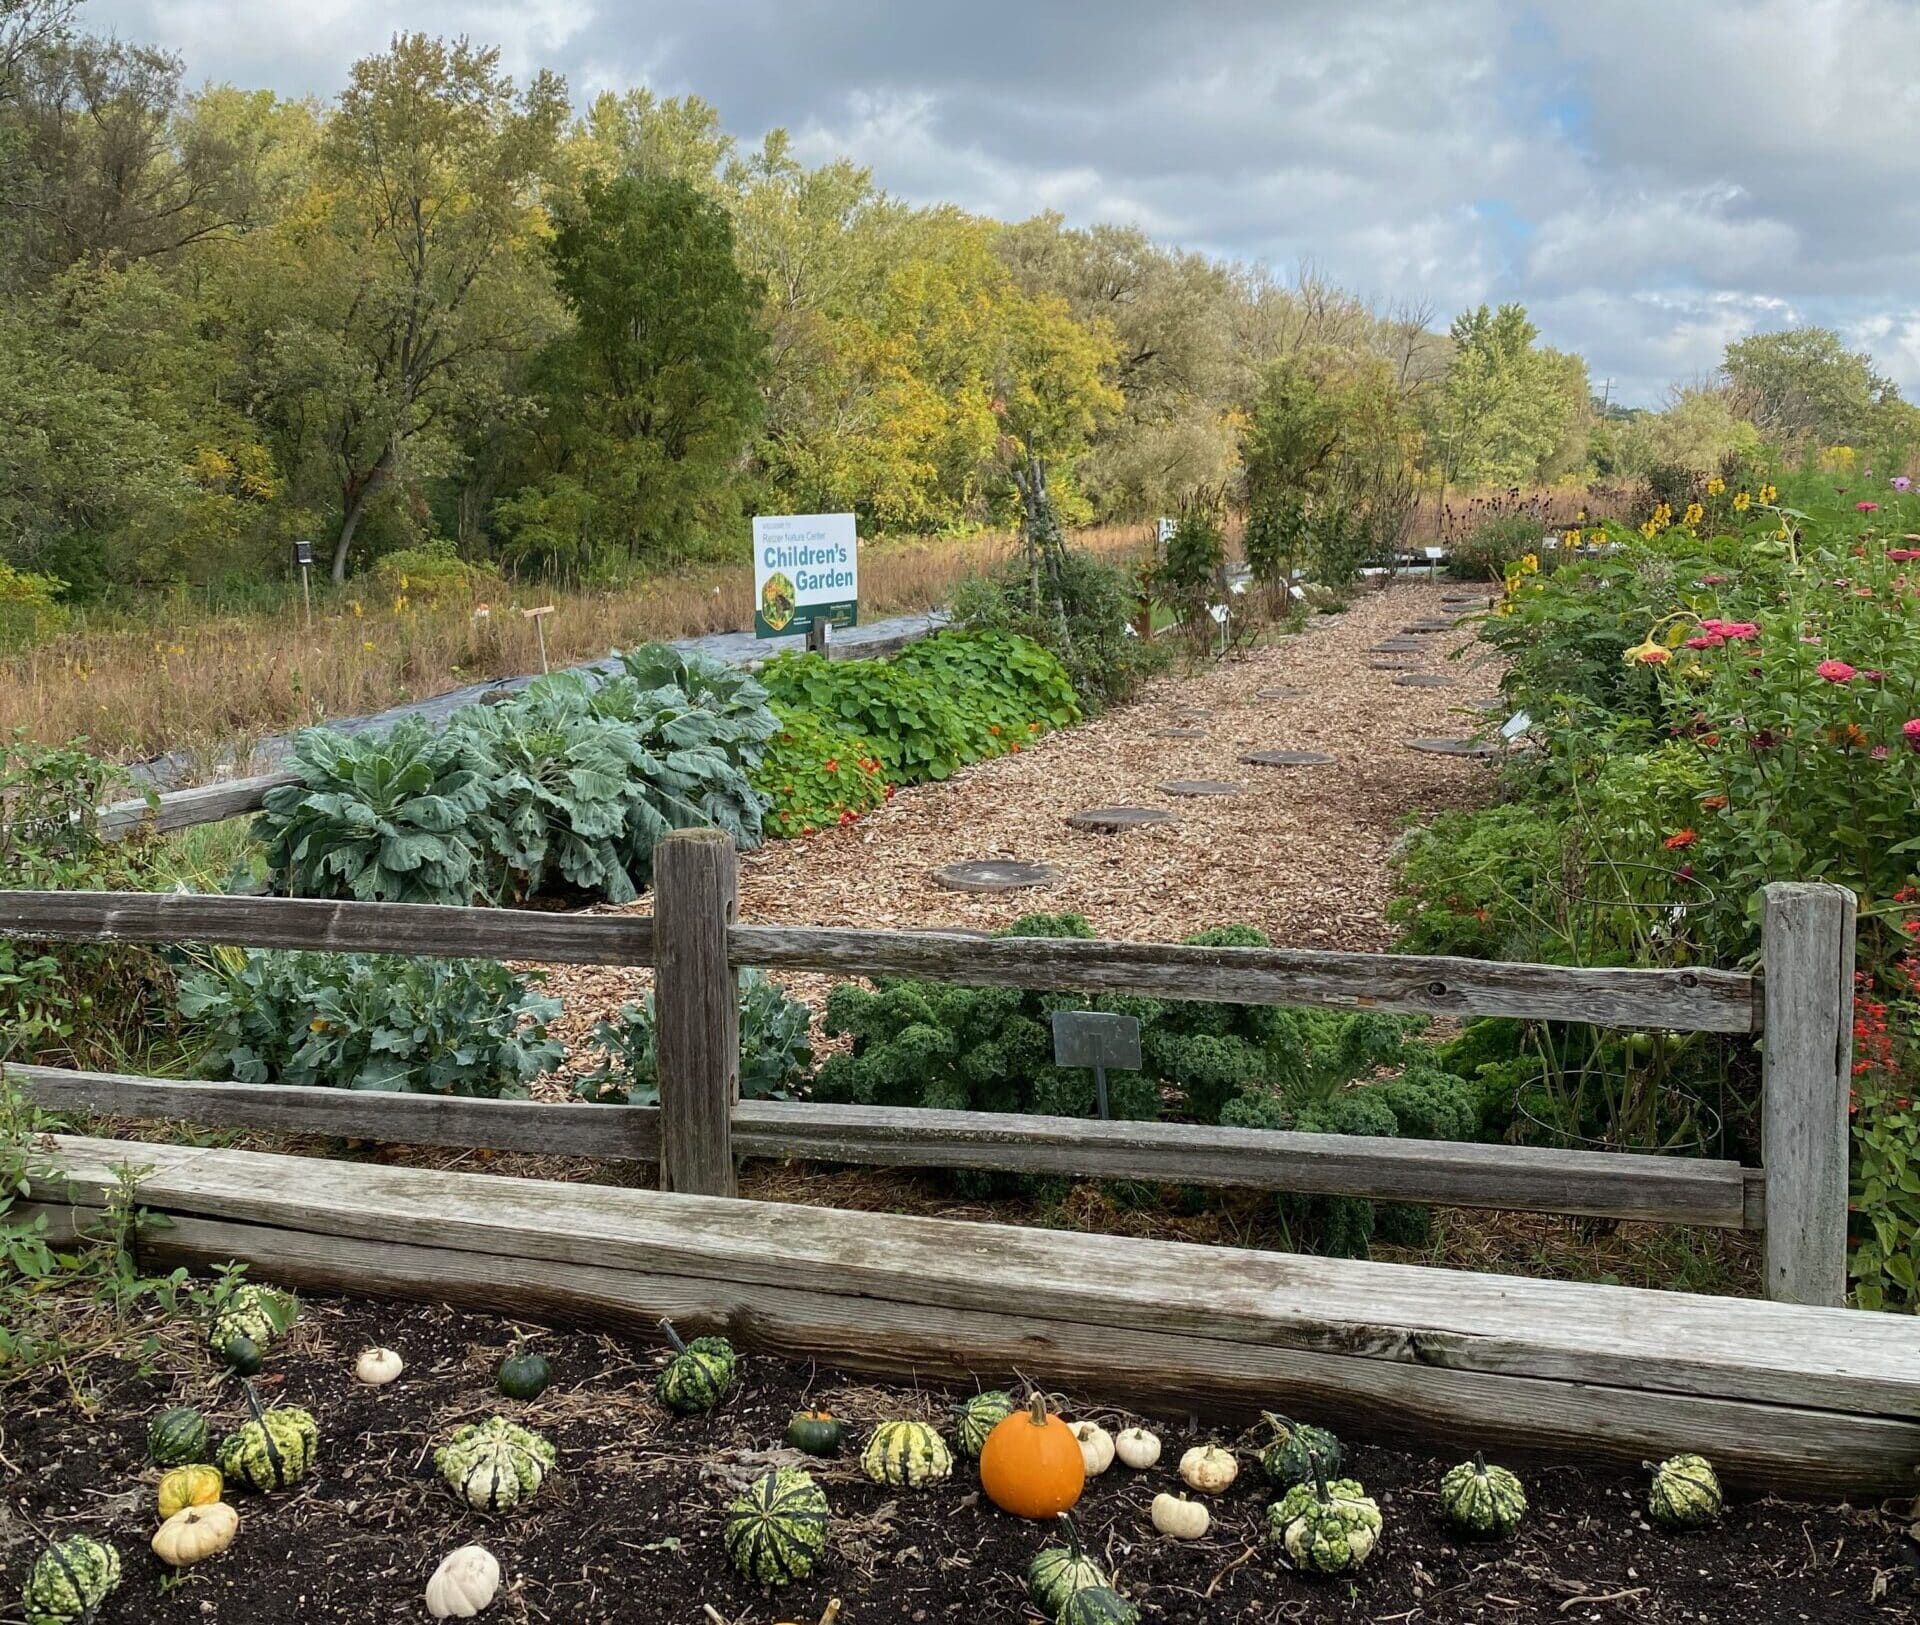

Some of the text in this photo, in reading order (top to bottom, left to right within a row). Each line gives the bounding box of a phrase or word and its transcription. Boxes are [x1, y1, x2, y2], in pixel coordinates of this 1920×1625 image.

[785, 532, 804, 542] Nature
[806, 531, 826, 541] Center
[764, 543, 847, 568] Children's
[796, 568, 853, 591] Garden
